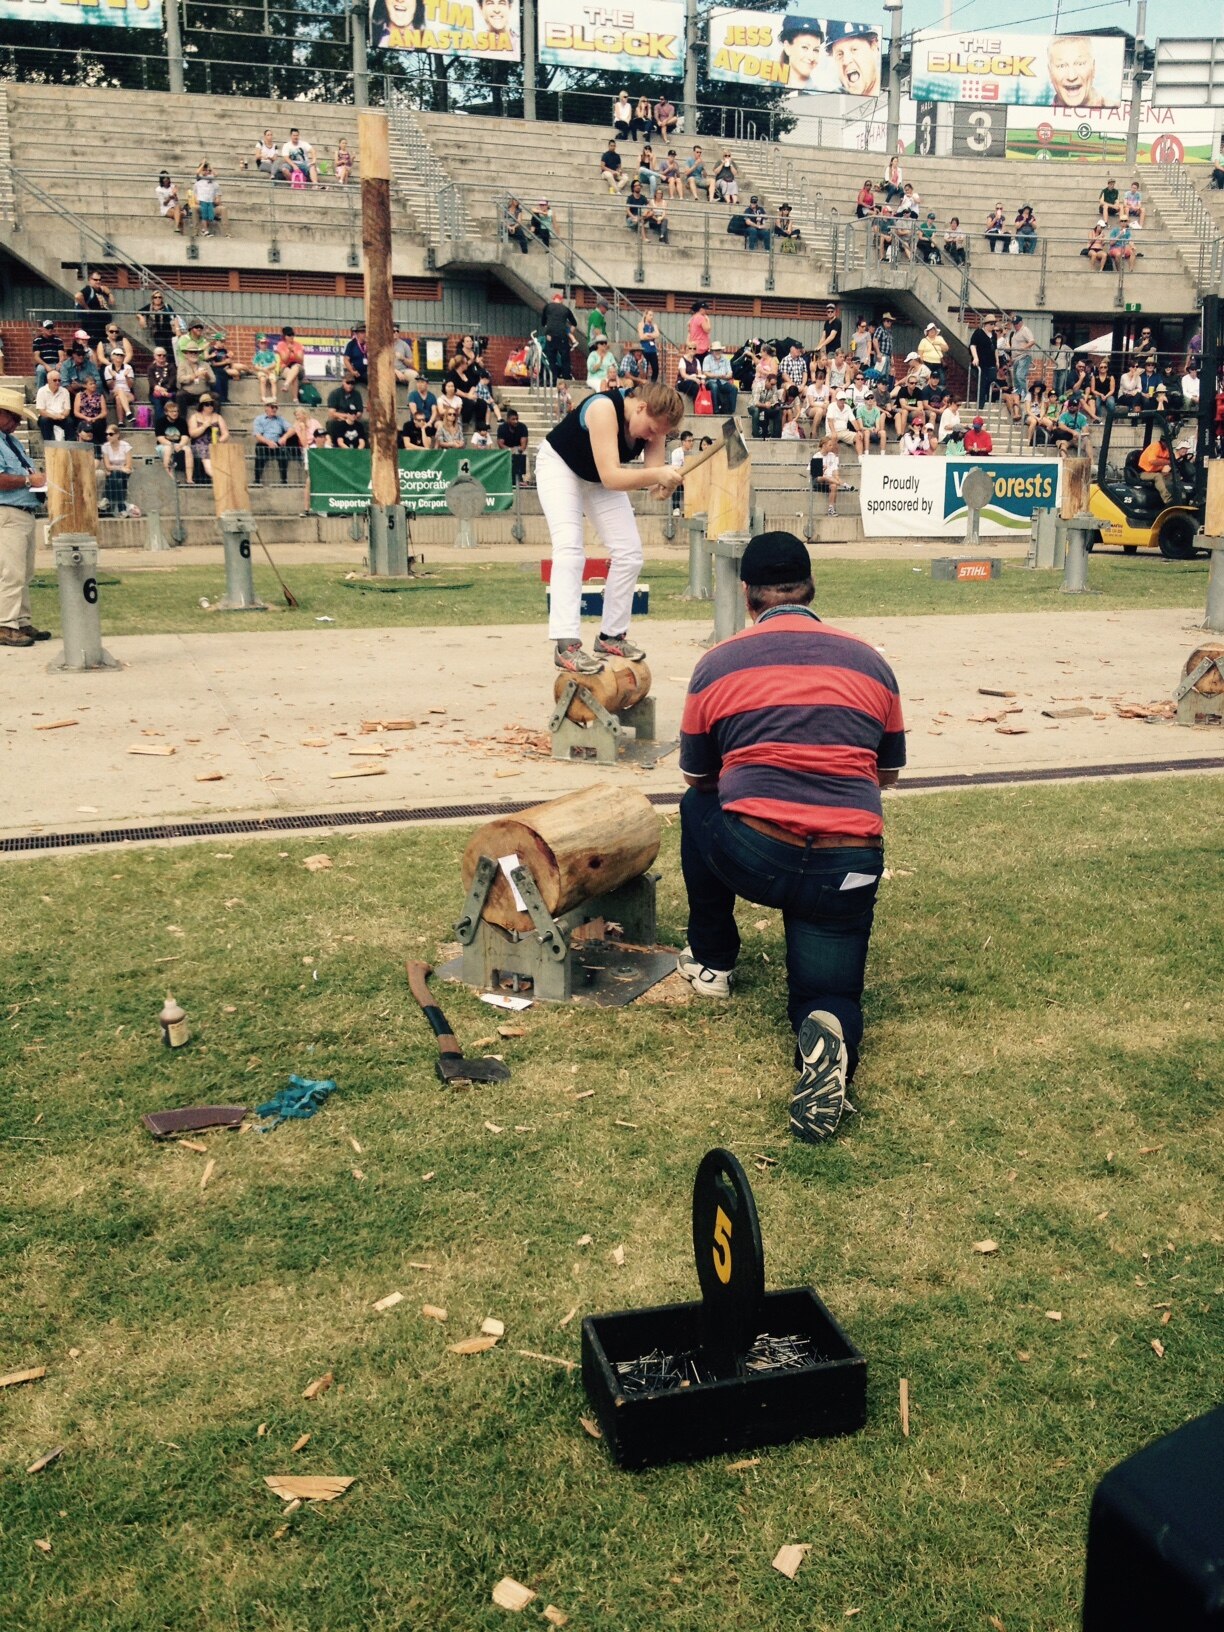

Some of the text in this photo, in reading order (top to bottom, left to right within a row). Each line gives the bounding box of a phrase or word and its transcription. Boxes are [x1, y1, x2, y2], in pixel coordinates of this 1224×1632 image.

[425, 0, 474, 30] TIM
[583, 5, 635, 29] THE
[388, 28, 514, 52] ANASTASIA
[545, 21, 678, 60] BLOCK
[723, 25, 773, 48] JESS
[959, 37, 1002, 54] THE
[713, 47, 791, 85] AYDEN
[927, 51, 1037, 77] BLOCK
[920, 101, 933, 113] HALL
[920, 116, 931, 155] 3
[967, 111, 992, 151] 3
[398, 469, 442, 480] Forestry
[461, 461, 469, 473] 4
[400, 479, 451, 491] Corporatio
[883, 475, 920, 493] Proudly
[953, 471, 1052, 498] Vorests
[328, 497, 371, 509] Supported
[867, 497, 933, 514] sponsored by
[388, 515, 395, 530] 5
[239, 539, 251, 558] 6
[958, 566, 987, 578] STIHL
[83, 578, 98, 604] 6
[712, 1204, 733, 1285] 5
